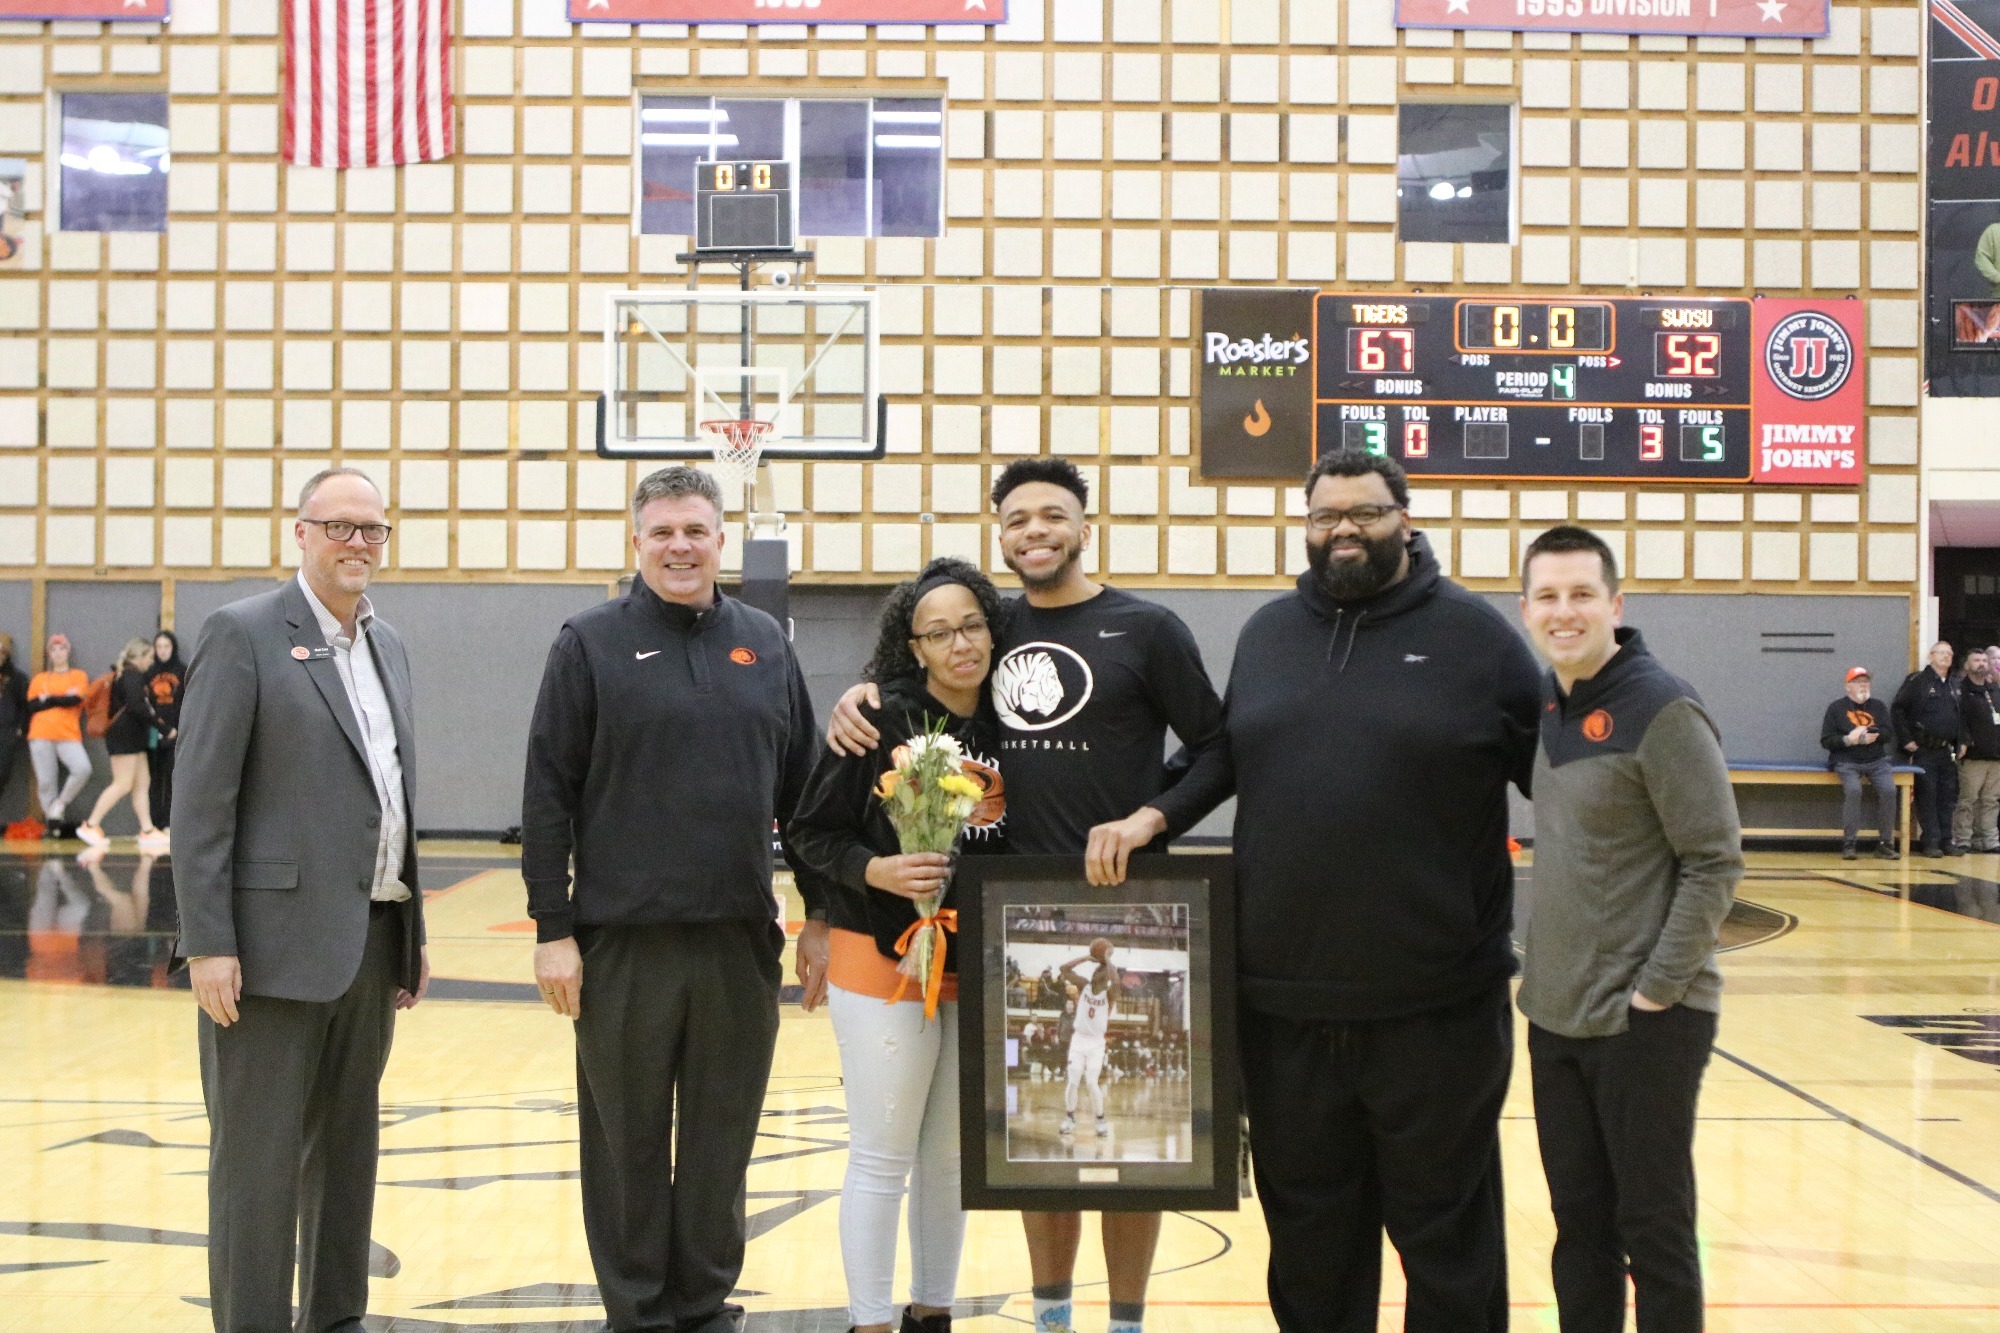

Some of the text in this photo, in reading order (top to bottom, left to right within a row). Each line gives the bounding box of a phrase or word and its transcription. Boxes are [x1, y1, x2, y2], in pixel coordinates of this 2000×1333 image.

[1590, 0, 1691, 17] DIVISION
[1971, 77, 2000, 111] O
[1351, 304, 1408, 323] TIGERS
[1661, 308, 1713, 327] SWOSU
[1360, 330, 1412, 371] 67
[1666, 334, 1719, 375] 52
[1789, 337, 1829, 378] JJ
[1460, 354, 1490, 366] POSS
[1577, 356, 1607, 368] POSS
[1219, 366, 1297, 377] MARKET
[1375, 379, 1423, 394] BONUS
[1495, 366, 1574, 398] PERIOD 4
[1644, 383, 1693, 398] BONUS
[1341, 405, 1386, 421] FOULS
[1403, 406, 1430, 421] TOL
[1455, 406, 1508, 421] PLAYER
[1568, 407, 1613, 422] FOULS
[1637, 409, 1665, 424] TOL
[1678, 409, 1724, 424] FOULS
[1363, 422, 1386, 456] 3
[1407, 422, 1427, 456] 0
[1642, 426, 1662, 459] 3
[1702, 427, 1723, 460] 5
[1762, 424, 1855, 447] JIMMY
[1762, 449, 1855, 472] JOHN'S
[1001, 740, 1090, 751] SKETBALL
